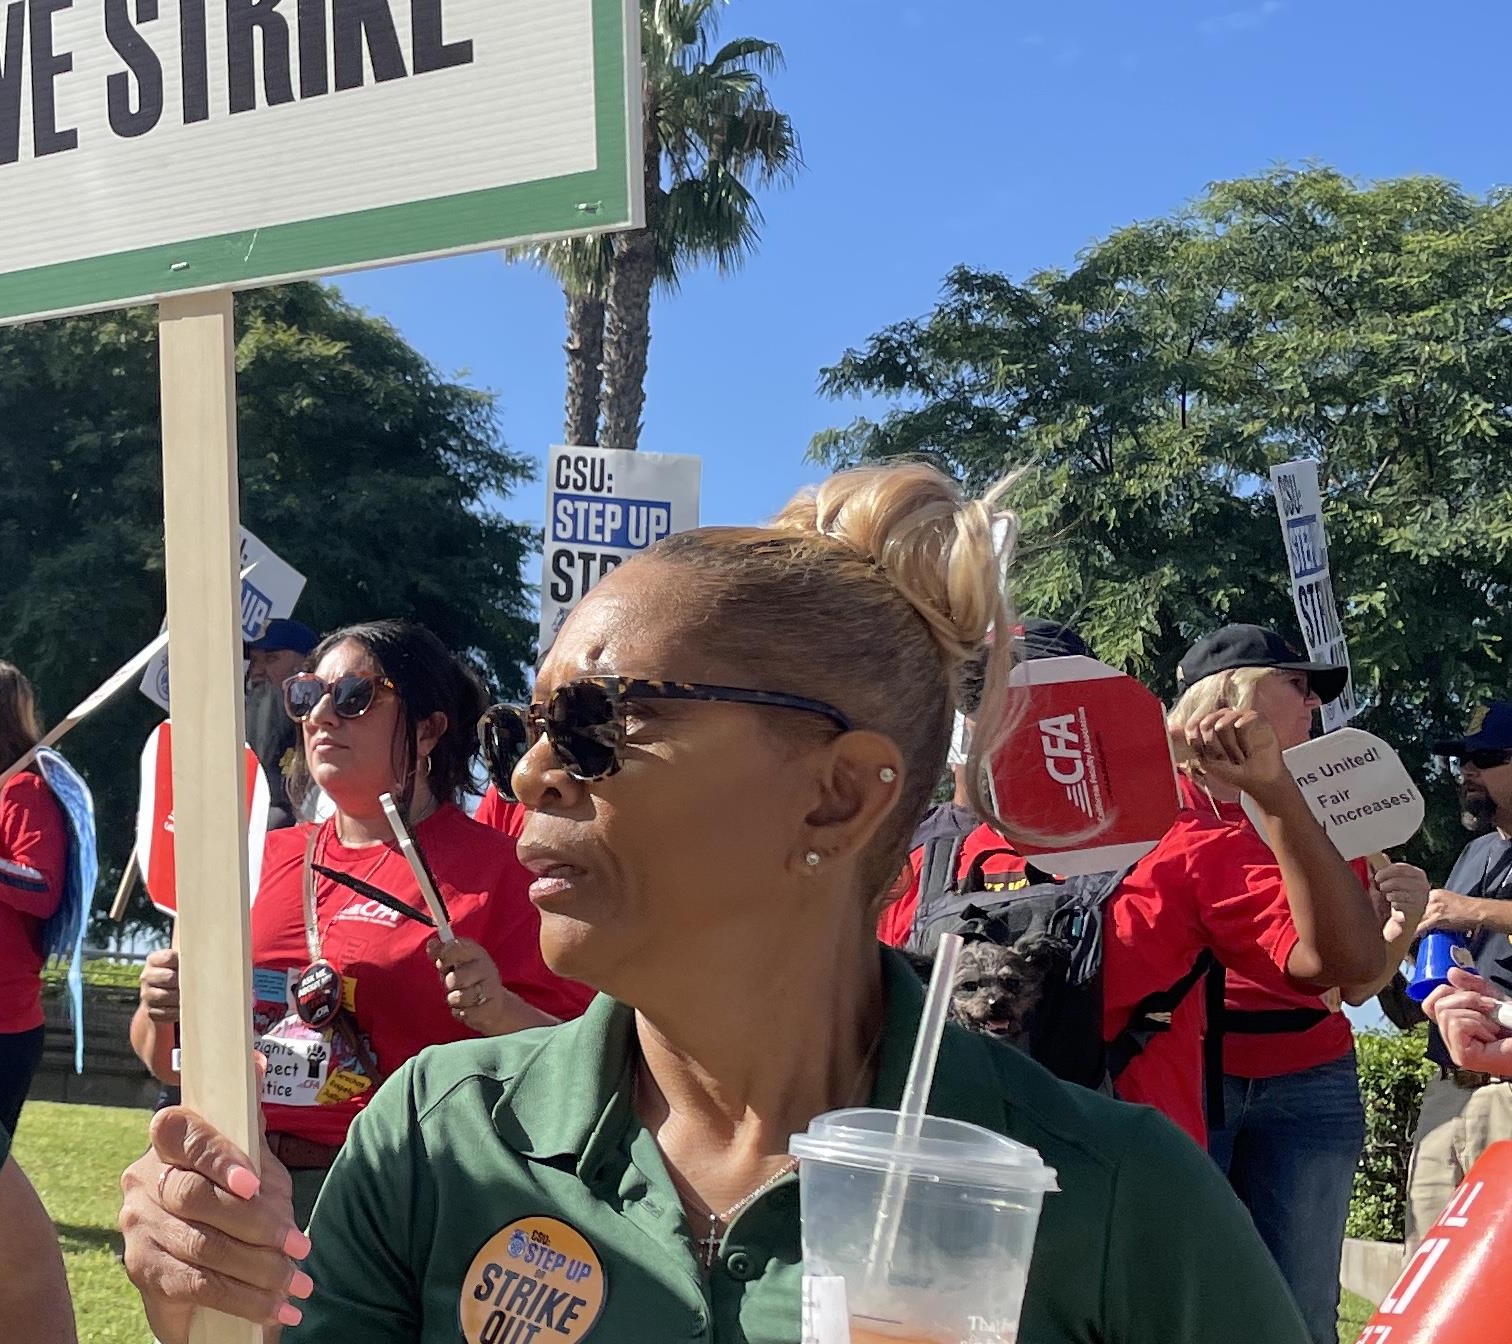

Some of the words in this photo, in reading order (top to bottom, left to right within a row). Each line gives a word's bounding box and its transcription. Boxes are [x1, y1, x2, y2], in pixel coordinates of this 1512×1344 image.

[555, 455, 614, 494] CSU:
[555, 498, 623, 543] STEP
[628, 506, 668, 547] UP
[1038, 714, 1085, 784] CFA
[1318, 746, 1382, 778] United!
[1316, 789, 1351, 809] Fair
[1329, 788, 1417, 827] Increases!
[524, 1243, 567, 1272] STEP
[566, 1259, 593, 1283] UP
[474, 1263, 587, 1335] STRIKE
